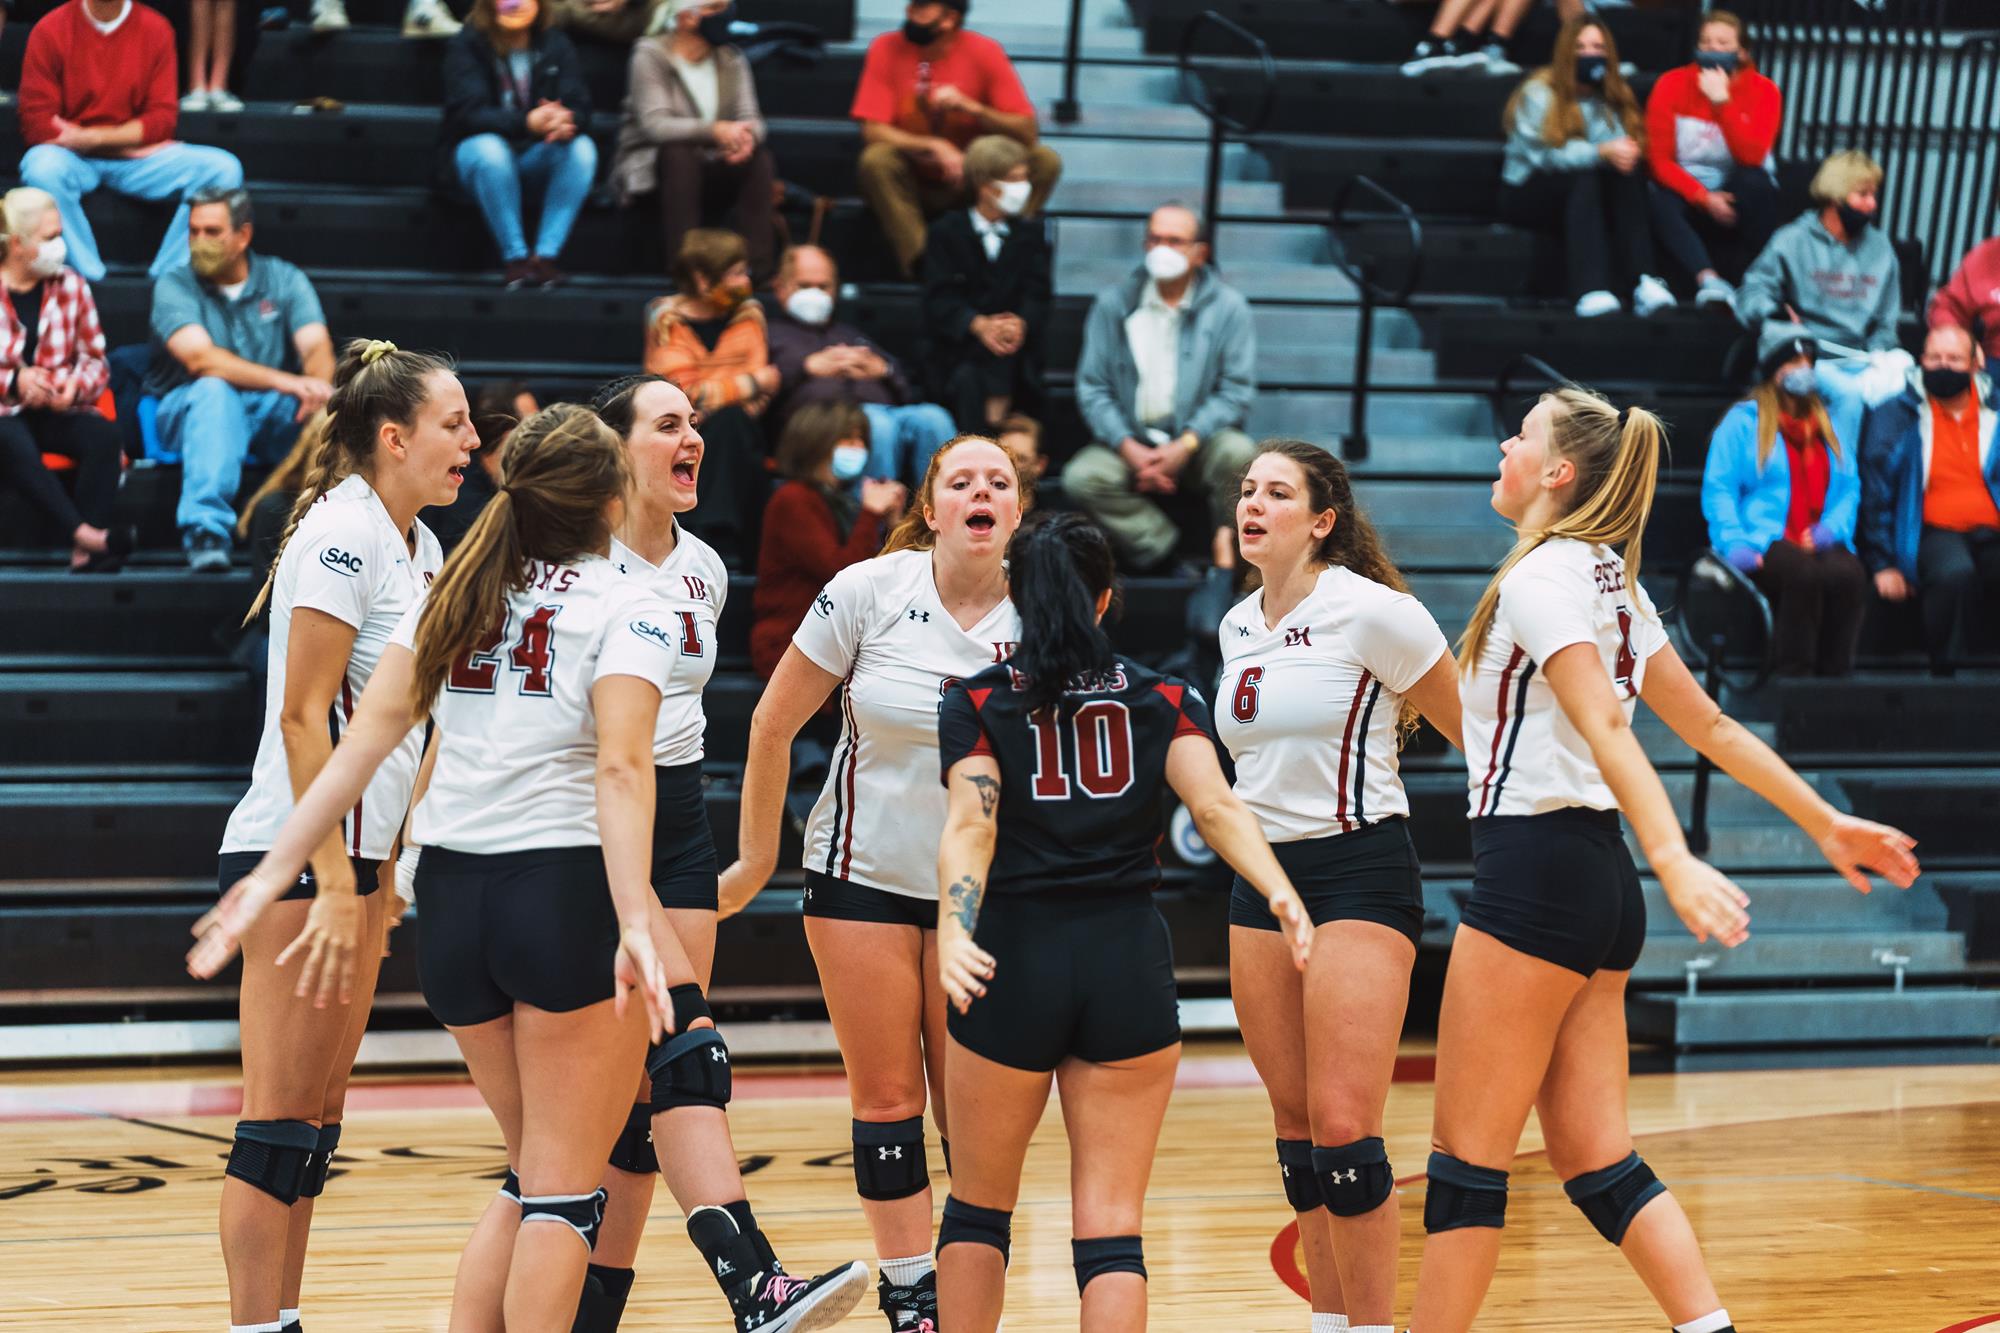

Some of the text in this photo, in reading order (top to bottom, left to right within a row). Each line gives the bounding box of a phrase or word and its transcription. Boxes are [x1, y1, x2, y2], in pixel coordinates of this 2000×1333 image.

[324, 547, 363, 573] SAC
[446, 600, 563, 698] 24
[636, 621, 672, 647] SAC
[1231, 665, 1266, 724] 6
[1027, 699, 1136, 801] 10
